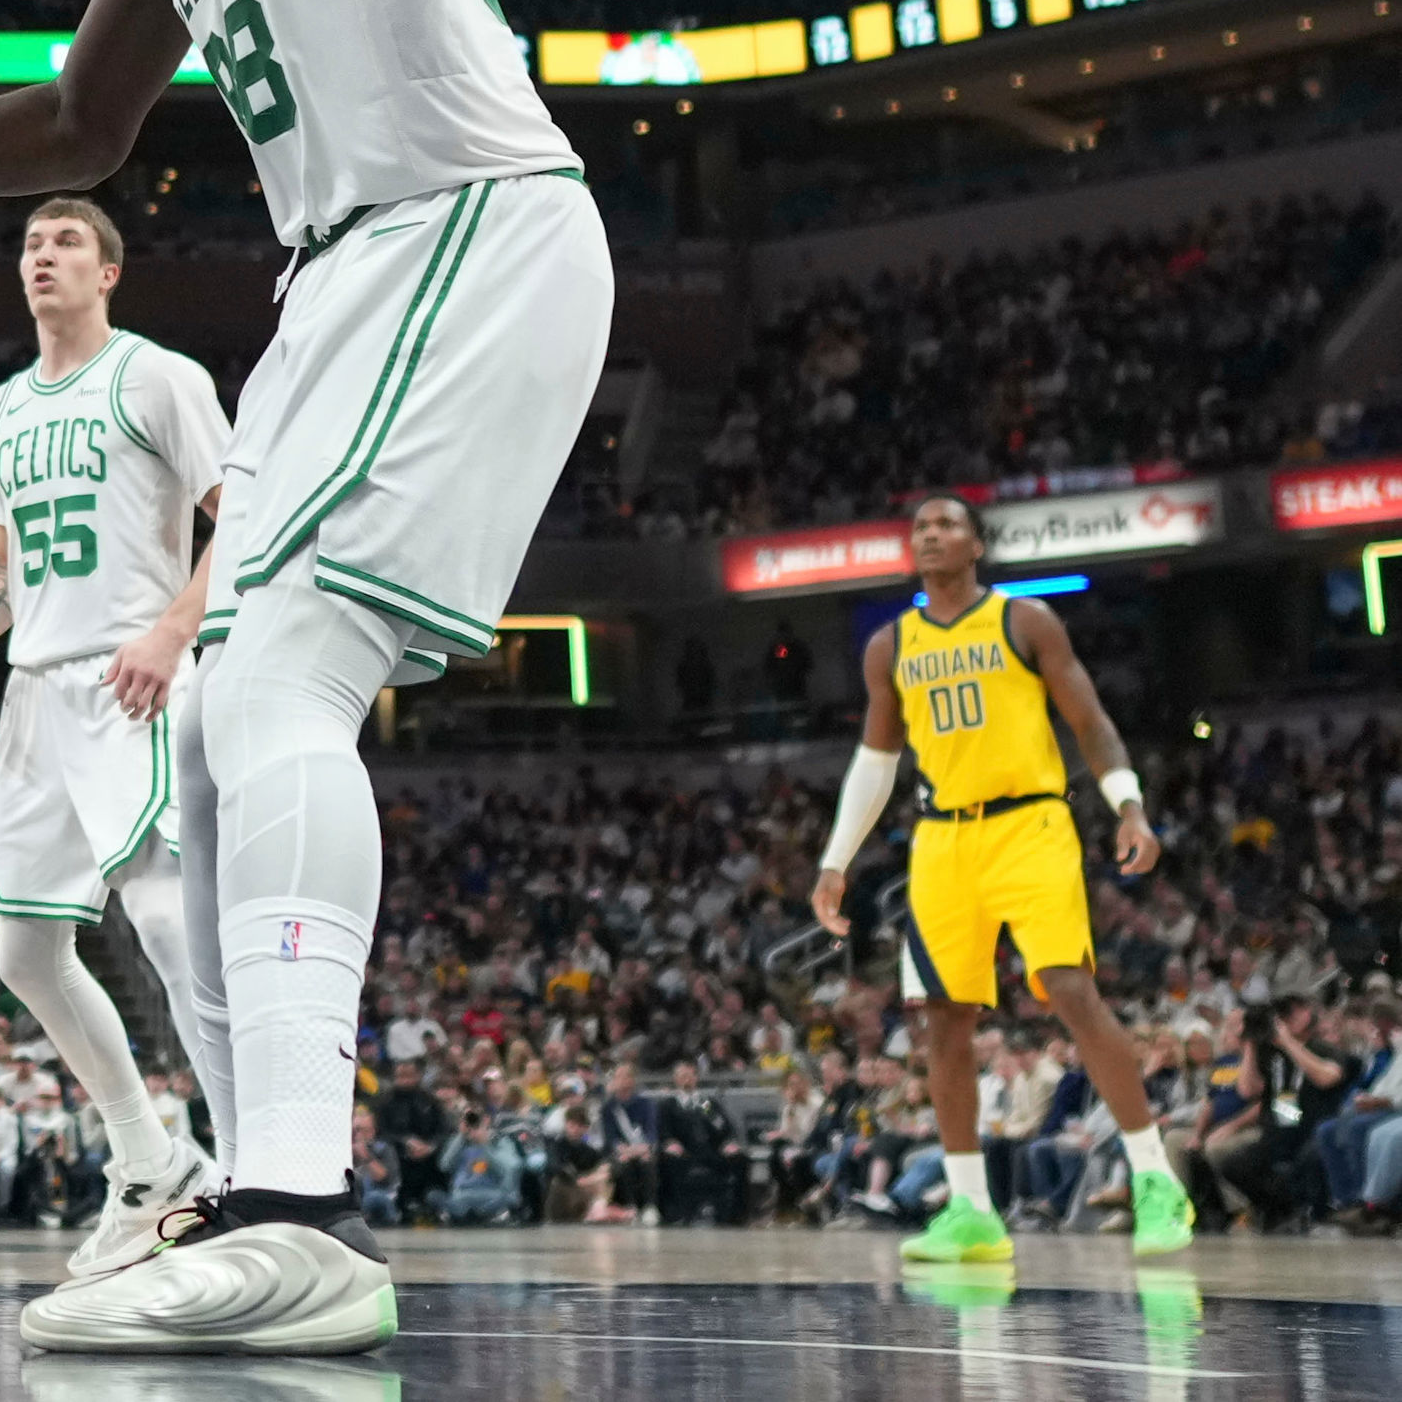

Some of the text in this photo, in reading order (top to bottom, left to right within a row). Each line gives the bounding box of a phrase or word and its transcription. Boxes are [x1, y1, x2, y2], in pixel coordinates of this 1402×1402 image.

[1280, 473, 1383, 518] STEAK
[12, 493, 98, 588] 55
[993, 509, 1134, 556] KeyBank
[901, 643, 1006, 689] INDIANA
[928, 680, 985, 735] 00
